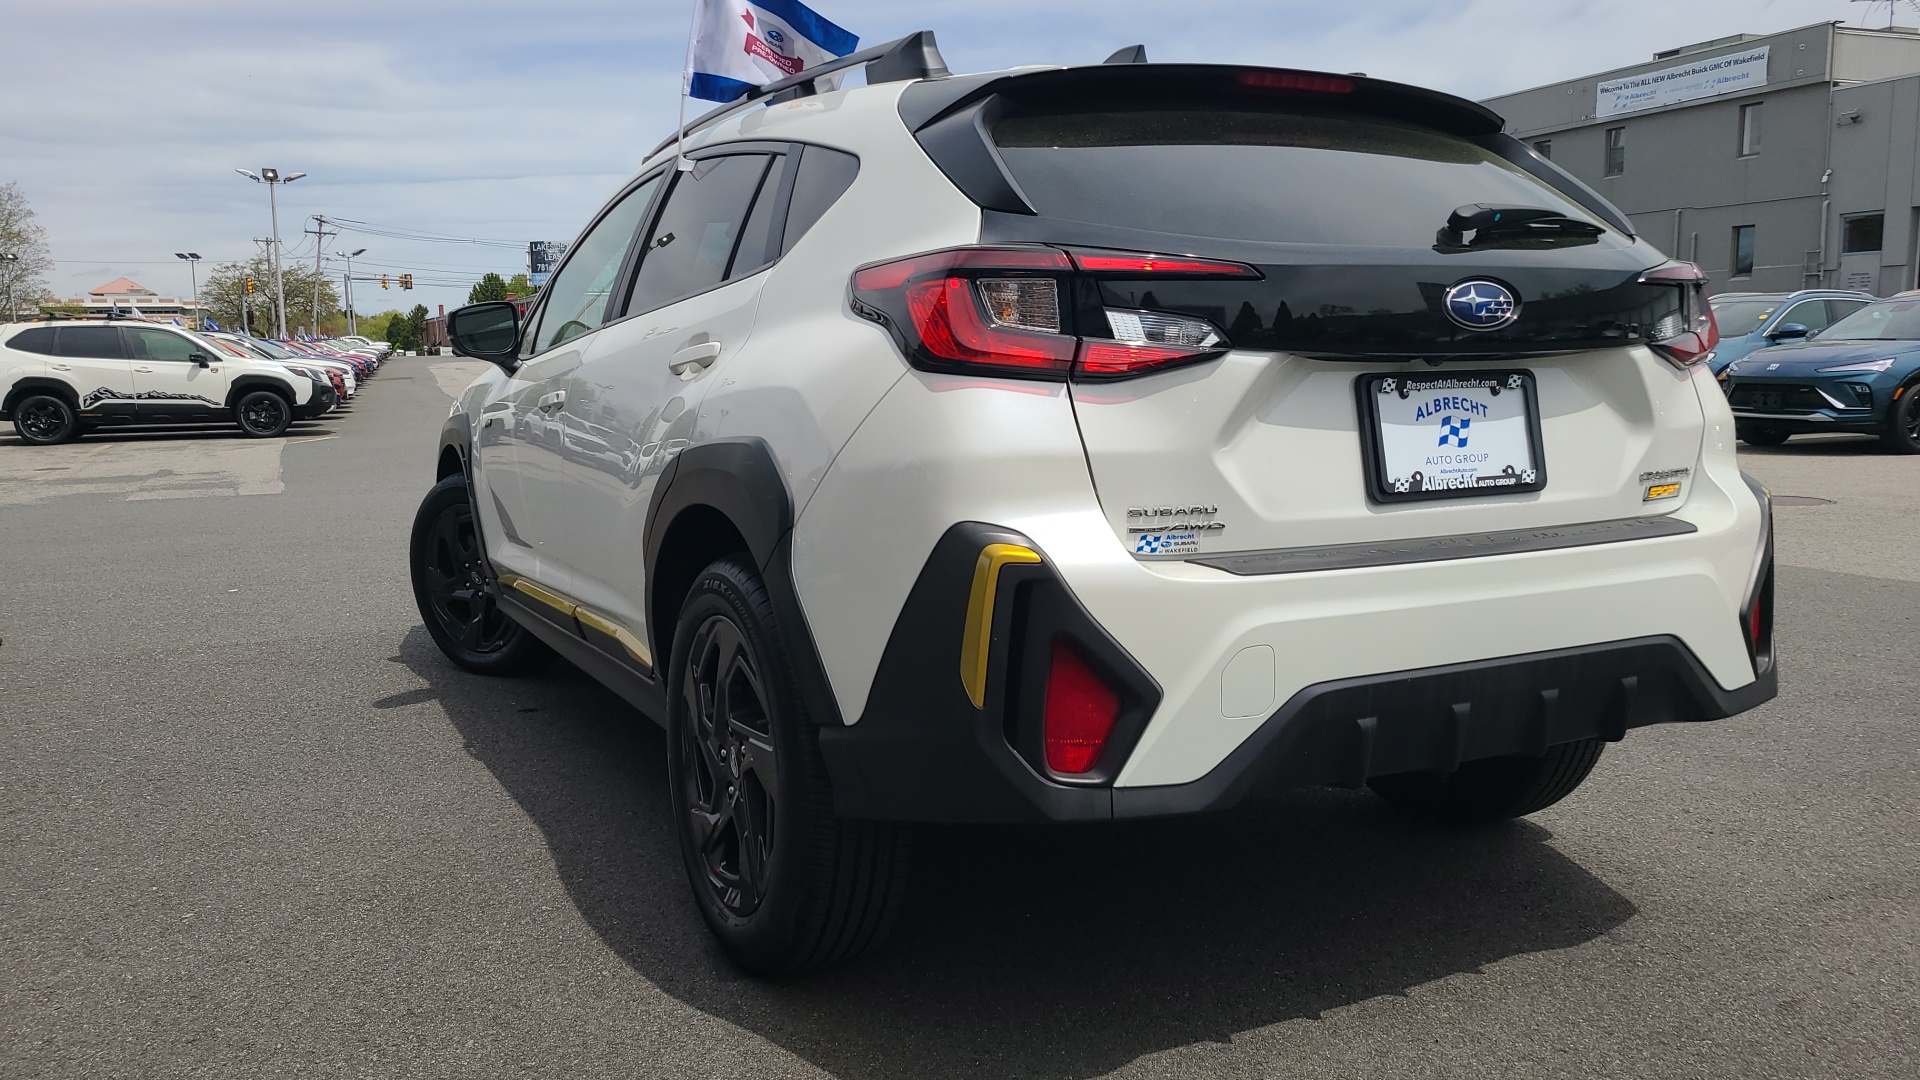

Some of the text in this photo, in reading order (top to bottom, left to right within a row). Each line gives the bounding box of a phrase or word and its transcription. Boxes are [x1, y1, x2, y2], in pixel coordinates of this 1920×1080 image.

[751, 44, 796, 74] PRE-OWNED
[756, 41, 792, 66] CERTIFIED
[1600, 86, 1623, 94] Welcome
[1630, 81, 1641, 89] The
[1652, 75, 1666, 84] NEW
[1666, 69, 1691, 81] Albrecht
[1691, 65, 1708, 76] Buick
[1732, 53, 1765, 66] Wakefield
[1716, 72, 1749, 85] Albrecht
[1629, 89, 1657, 100] Albrecht
[1406, 379, 1498, 390] RespectAtAlbrecht.com
[1415, 396, 1488, 421] ALBRECHT
[1425, 453, 1489, 466] AUTO GROUP
[1421, 474, 1516, 492] Albrecht AUTO GROUP
[1127, 504, 1218, 518] SUBARU
[1168, 521, 1226, 532] AWD
[703, 579, 727, 593] ZIEX
